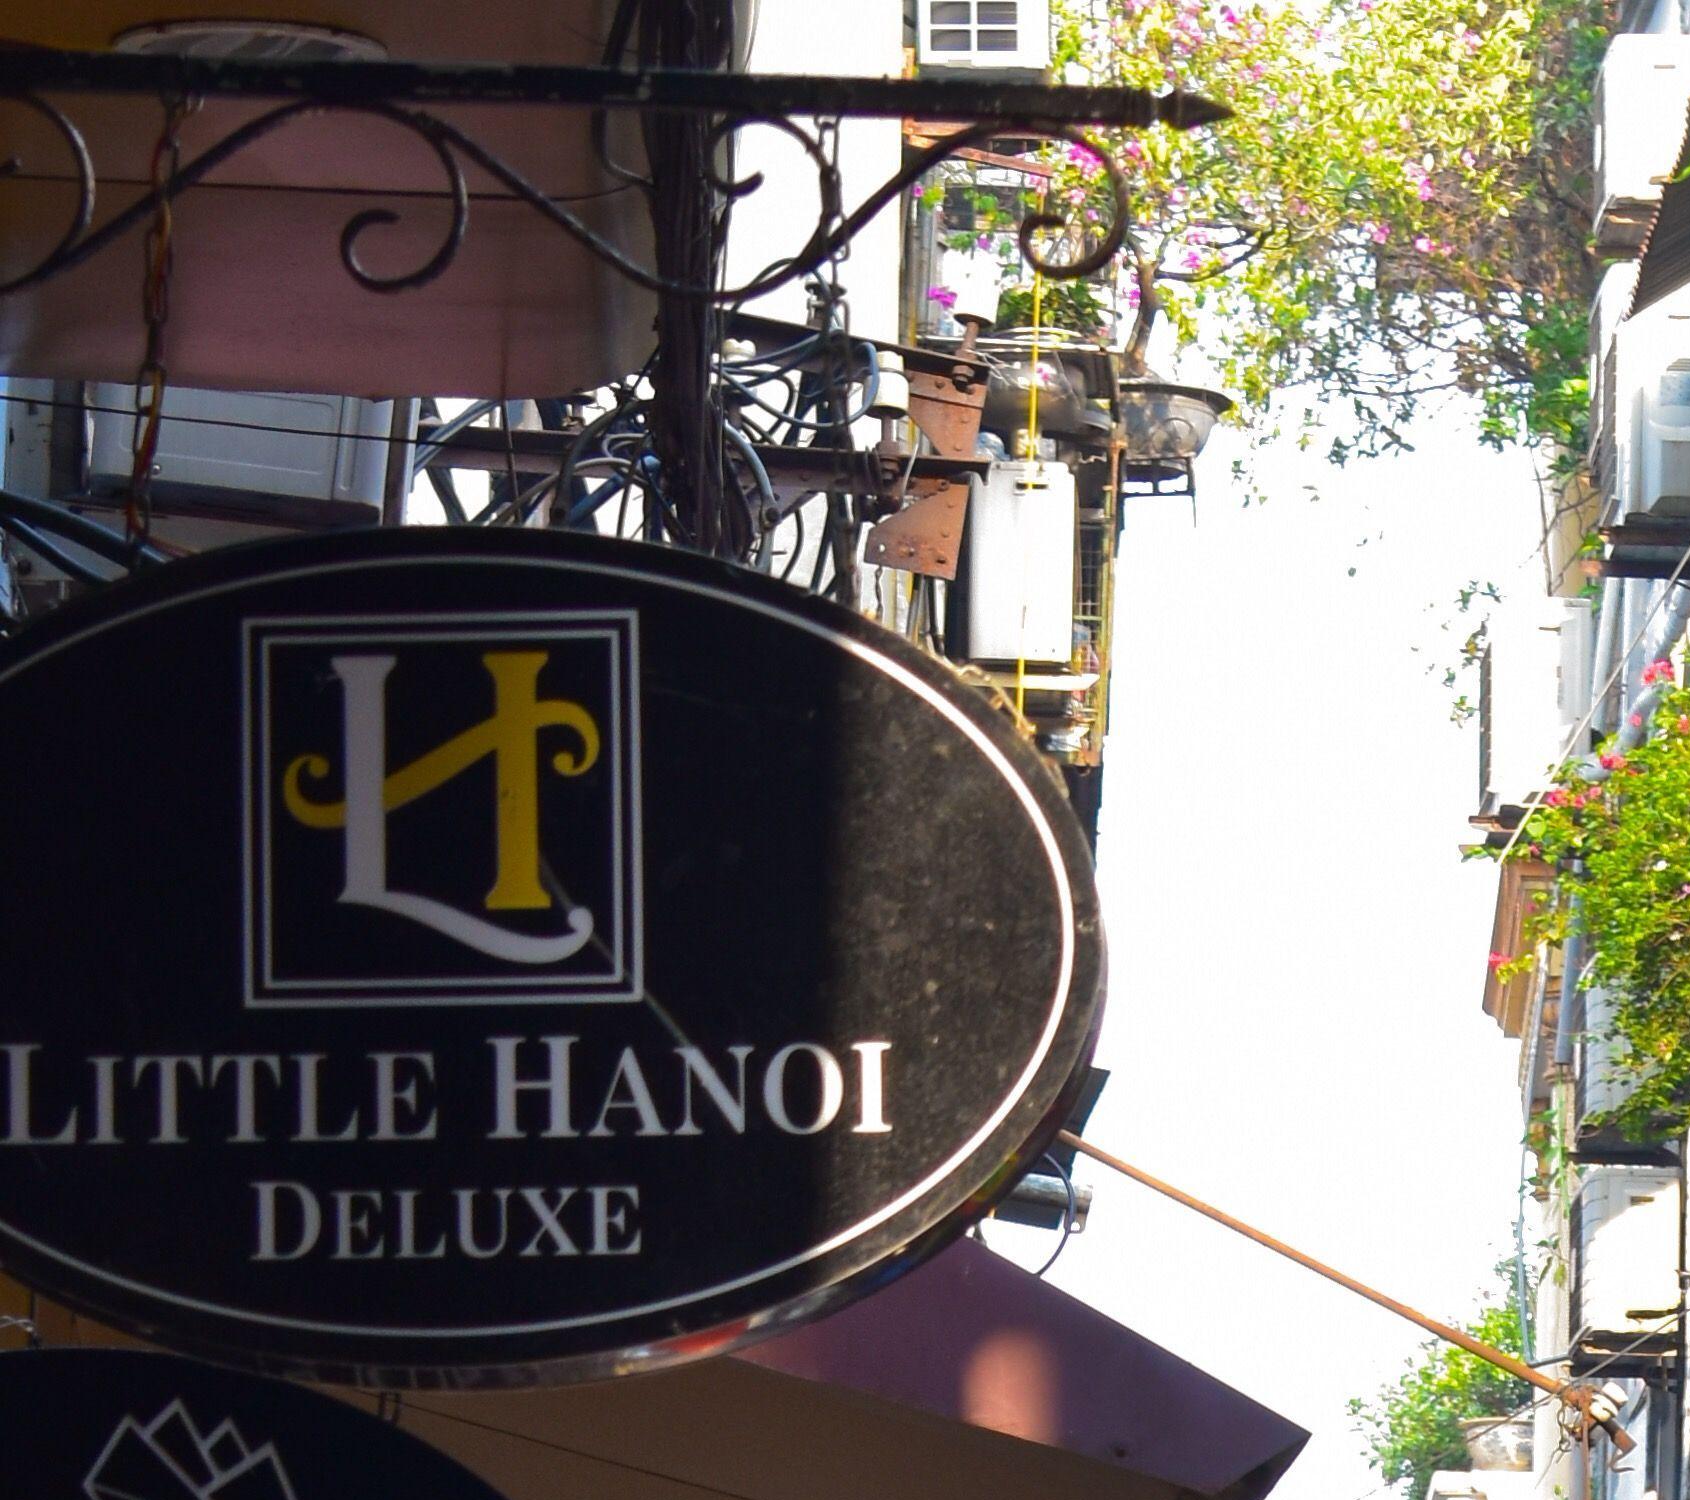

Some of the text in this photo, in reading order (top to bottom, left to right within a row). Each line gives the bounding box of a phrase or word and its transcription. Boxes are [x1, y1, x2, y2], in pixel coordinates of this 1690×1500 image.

[0, 1035, 893, 1147] LITTLE HANOI
[250, 1180, 642, 1262] DELUXE
